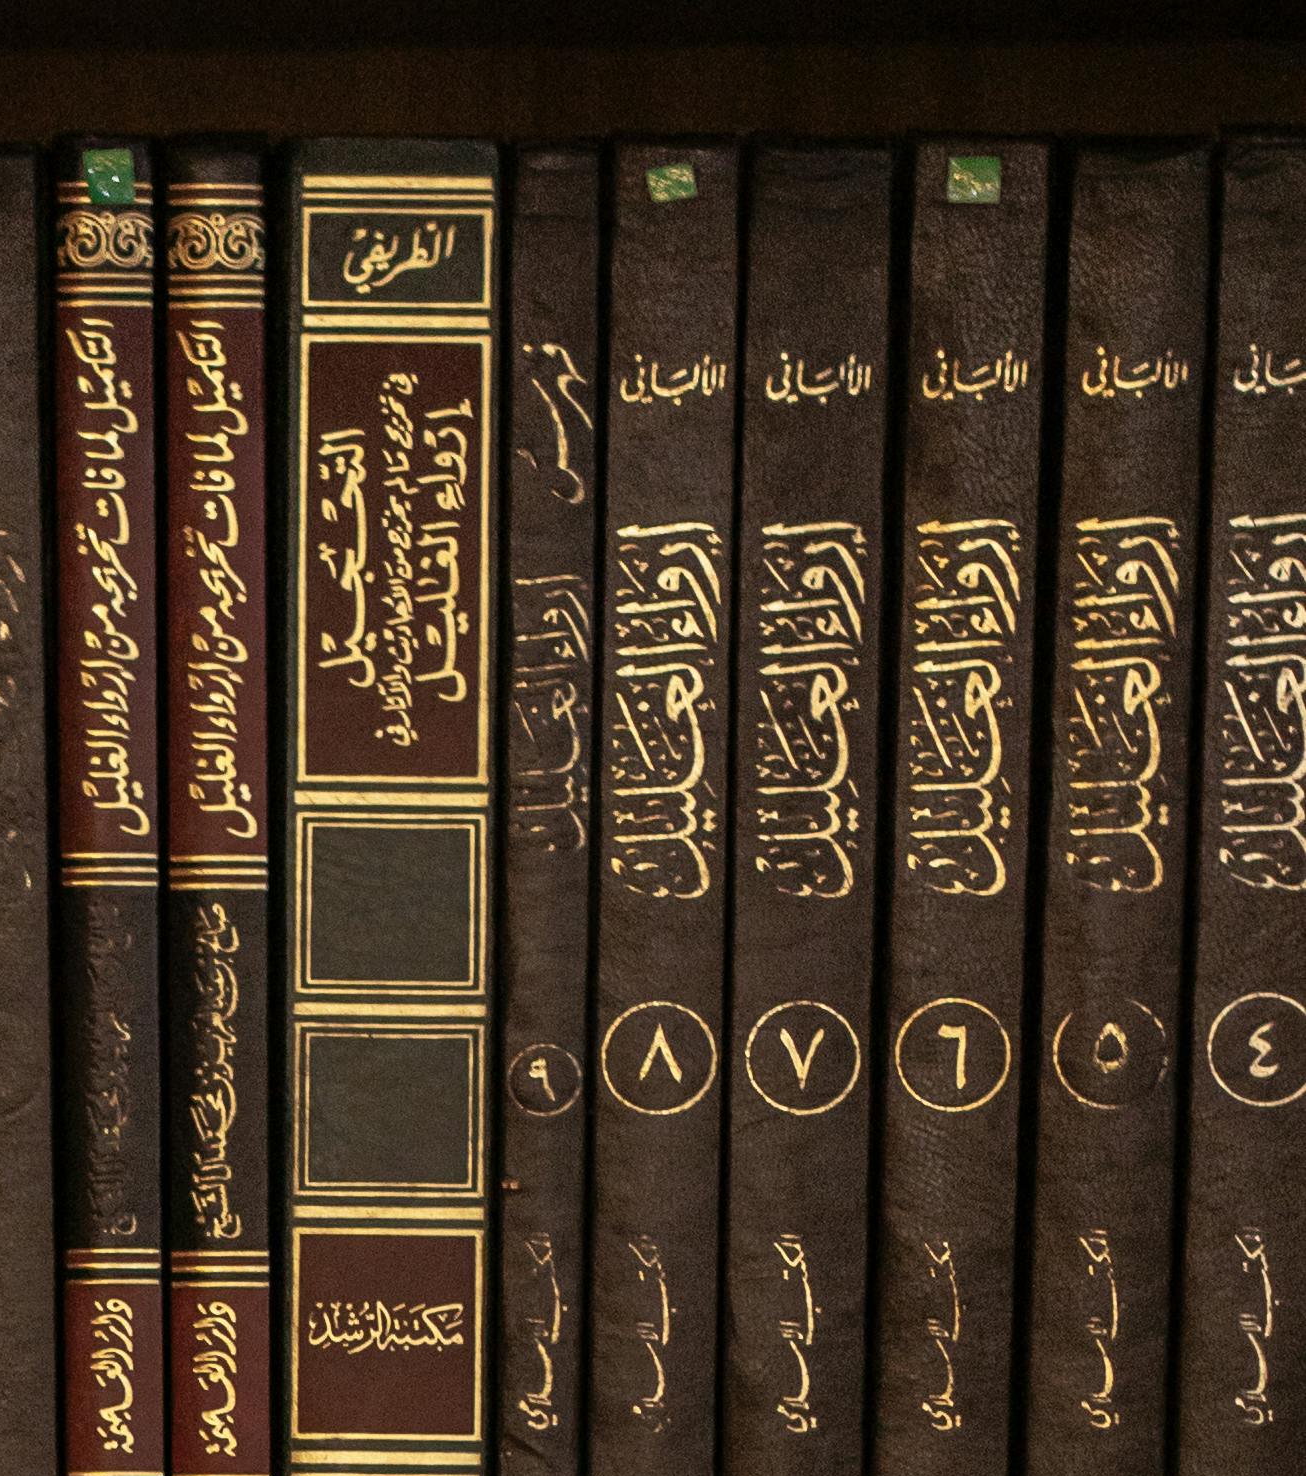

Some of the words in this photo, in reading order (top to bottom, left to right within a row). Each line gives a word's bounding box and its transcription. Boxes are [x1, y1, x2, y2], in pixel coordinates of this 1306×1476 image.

[639, 1023, 683, 1083] ٨
[779, 1028, 825, 1090] ٧
[937, 1024, 967, 1090] ٦
[1094, 1022, 1129, 1074] ٥
[1248, 1022, 1279, 1078] ٤
